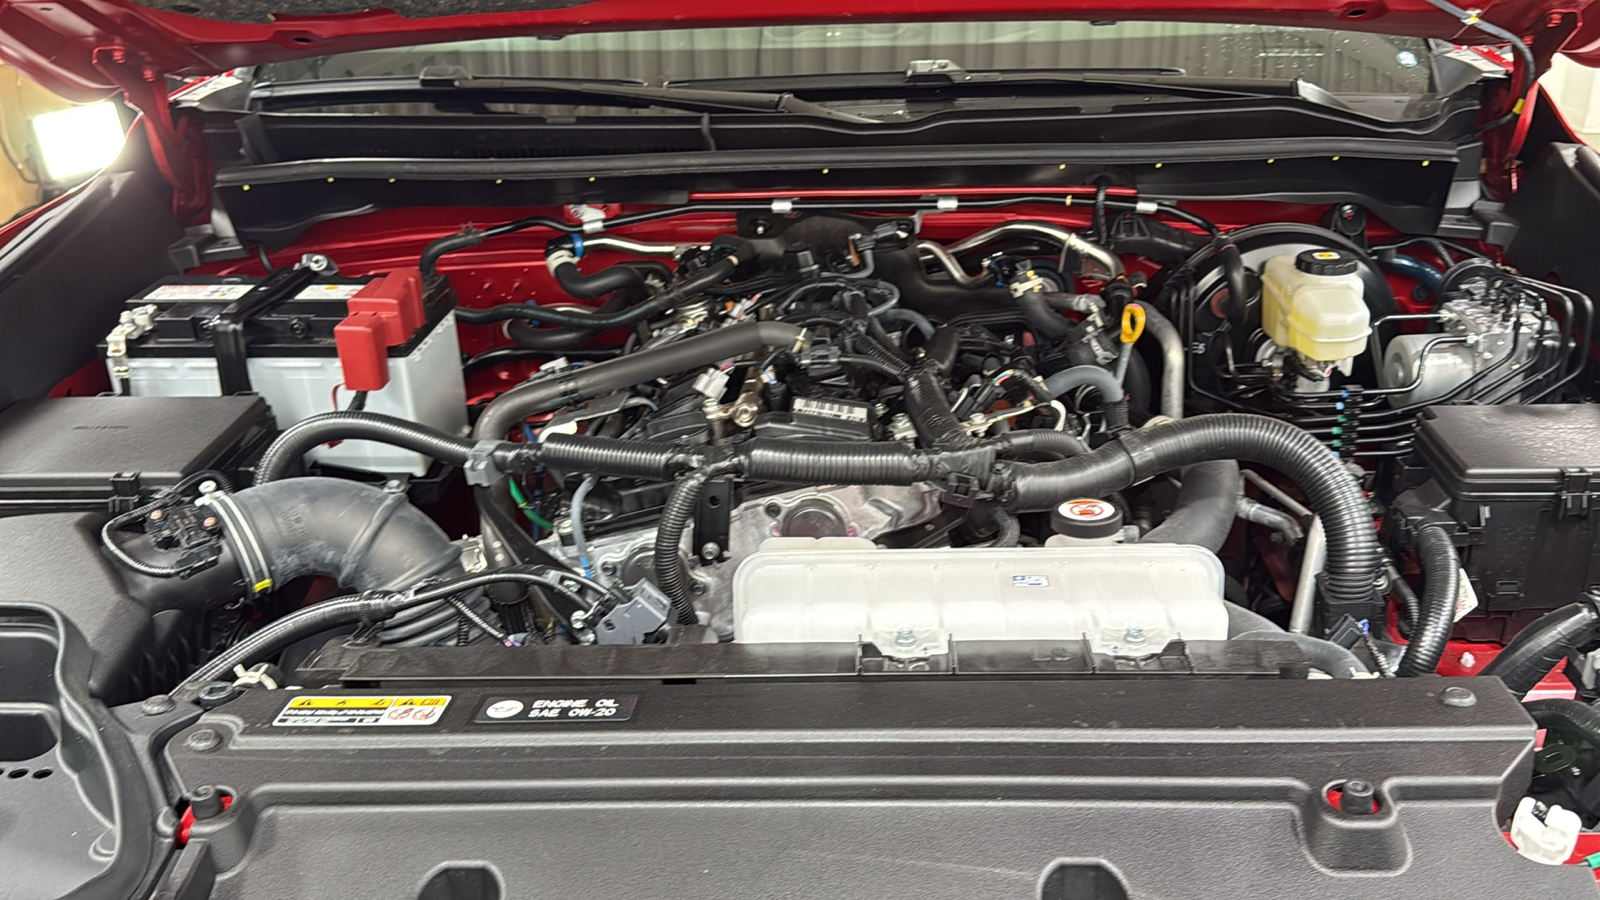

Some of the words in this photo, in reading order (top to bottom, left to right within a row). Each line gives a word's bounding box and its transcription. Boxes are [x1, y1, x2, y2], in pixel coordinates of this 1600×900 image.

[532, 699, 588, 708] ENGINE
[594, 699, 619, 707] OIL
[528, 708, 561, 717] SAE
[568, 708, 617, 717] 0W-20
